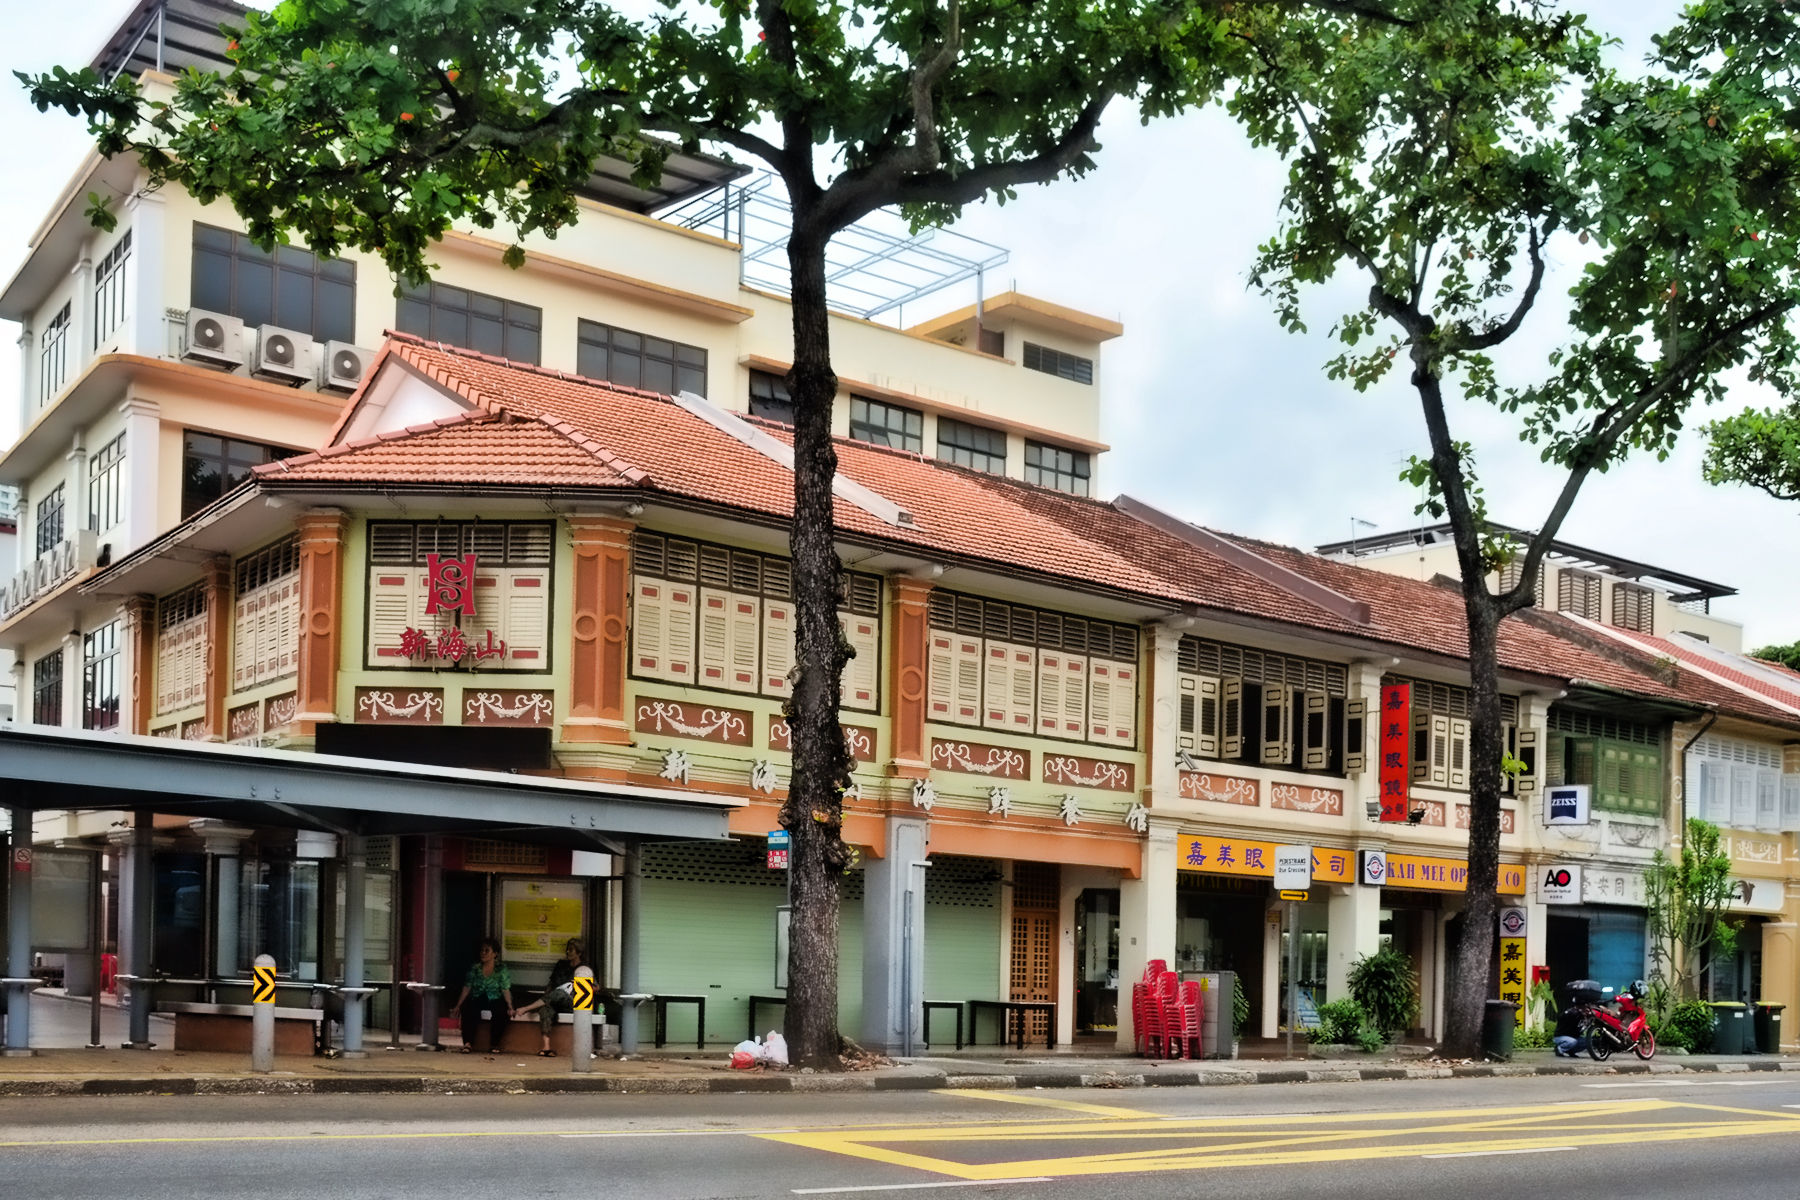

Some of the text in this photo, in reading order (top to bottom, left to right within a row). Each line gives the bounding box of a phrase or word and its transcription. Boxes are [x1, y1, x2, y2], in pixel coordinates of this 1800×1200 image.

[394, 626, 507, 662] 新海山
[1384, 691, 1404, 796] 嘉美眼鏡
[1384, 803, 1404, 815] 公司
[1551, 798, 1577, 807] ZEISS
[1387, 862, 1415, 880] KAH
[1421, 864, 1446, 882] MEE
[1505, 871, 1520, 888] CO
[1544, 869, 1571, 888] AO
